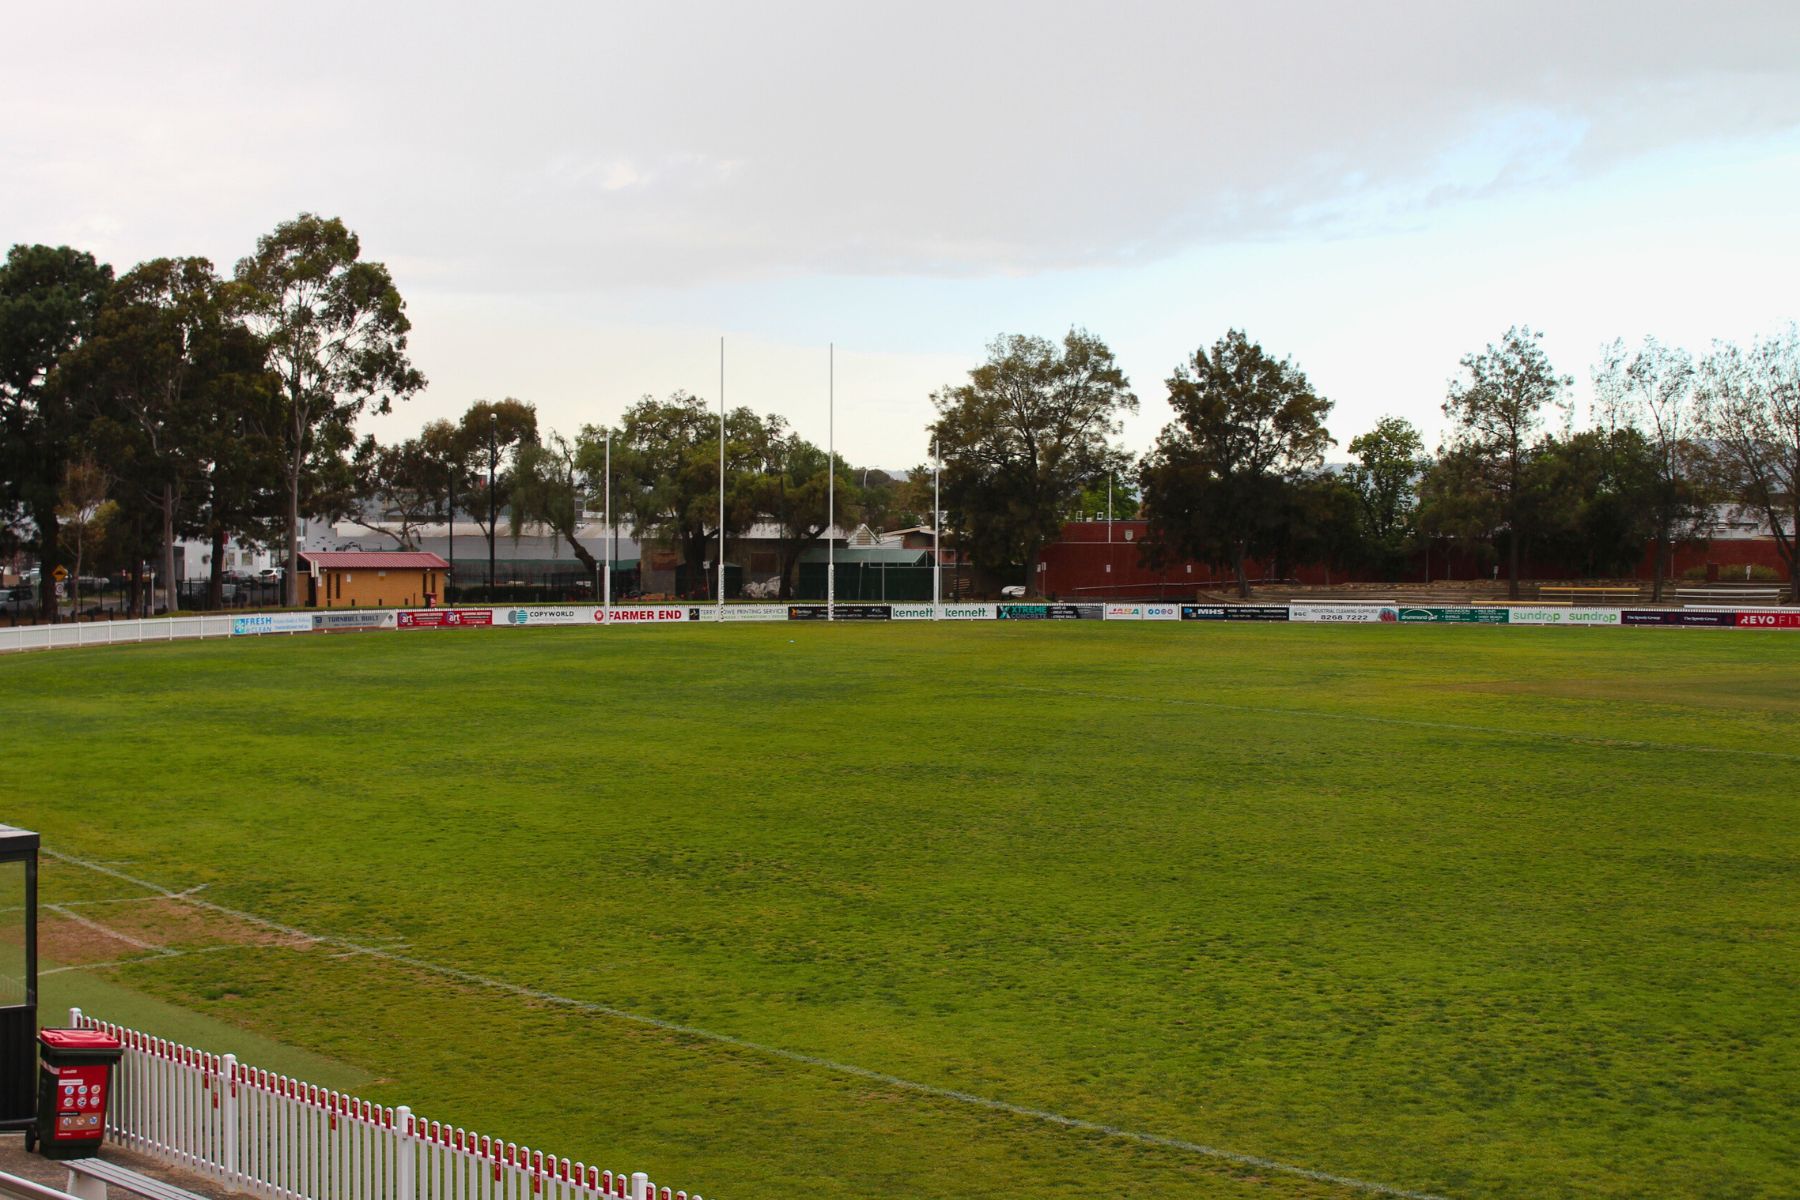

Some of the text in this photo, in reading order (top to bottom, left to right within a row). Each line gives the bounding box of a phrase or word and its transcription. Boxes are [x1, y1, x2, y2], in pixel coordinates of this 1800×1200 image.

[609, 610, 682, 620] FARMER END
[893, 608, 933, 617] kennett
[1513, 611, 1561, 622] sundrop
[1568, 611, 1617, 623] sundrop
[245, 616, 272, 625] FRESH
[402, 614, 413, 623] art
[449, 613, 460, 622] art
[1740, 615, 1776, 624] REVO
